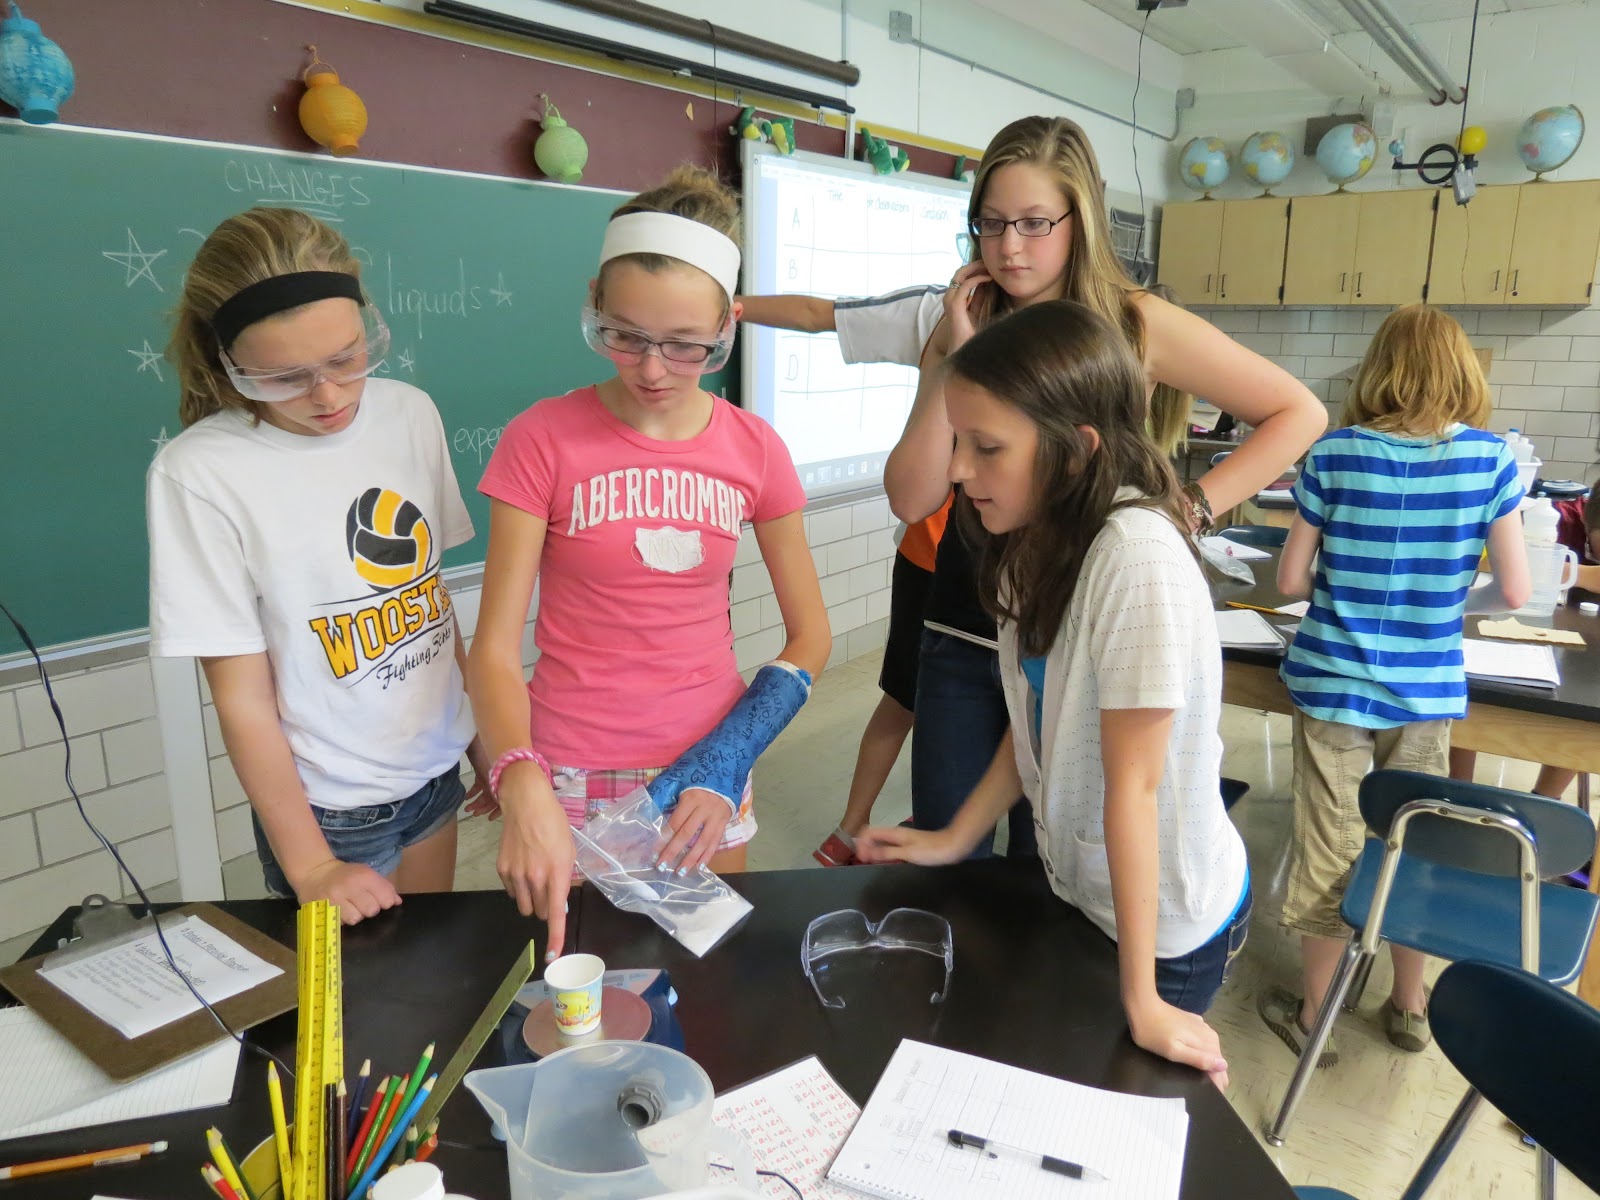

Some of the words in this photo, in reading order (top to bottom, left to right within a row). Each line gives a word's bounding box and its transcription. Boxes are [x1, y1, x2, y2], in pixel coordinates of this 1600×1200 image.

[224, 160, 371, 206] CHANGES
[791, 207, 801, 230] A
[787, 258, 799, 280] B
[388, 252, 481, 339] liquids
[785, 353, 799, 382] D
[567, 467, 746, 541] ABERCROMBIE
[376, 648, 431, 690] Fighting
